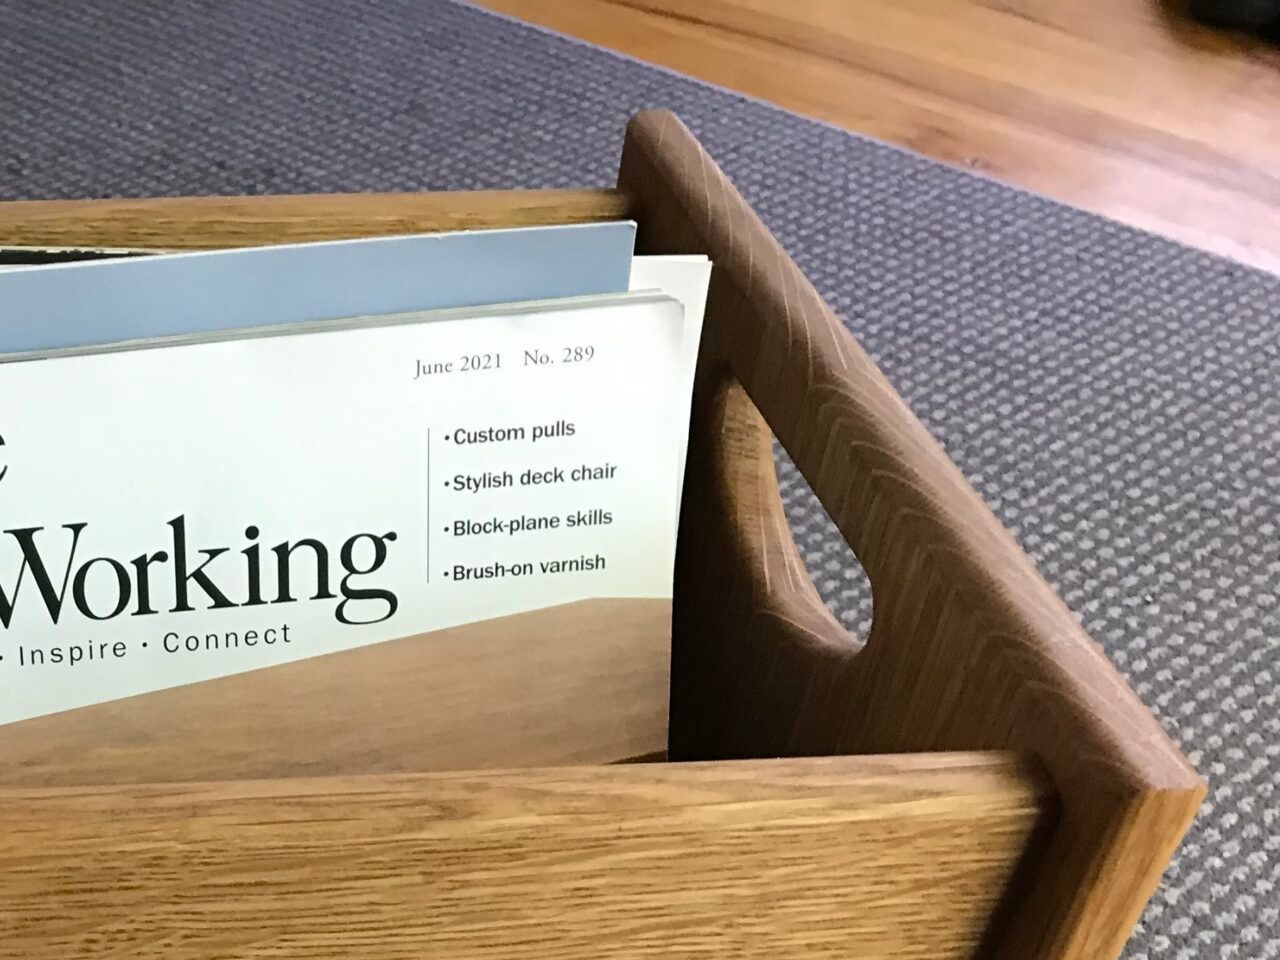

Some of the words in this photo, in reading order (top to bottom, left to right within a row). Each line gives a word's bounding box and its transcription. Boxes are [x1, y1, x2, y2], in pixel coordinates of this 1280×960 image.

[414, 359, 453, 379] June
[460, 353, 502, 372] 2021
[524, 349, 555, 367] No.
[563, 345, 596, 363] 289
[453, 425, 525, 446] Custom
[532, 420, 576, 443] pulls
[453, 473, 513, 494] Stylish
[520, 467, 565, 486] deck
[571, 462, 617, 482] chair
[453, 513, 560, 537] Block-plane
[566, 508, 613, 528] skills
[453, 560, 533, 581] Brush-on
[540, 554, 606, 575] varnish
[19, 638, 127, 667] Inspire
[163, 623, 292, 654] Connect
